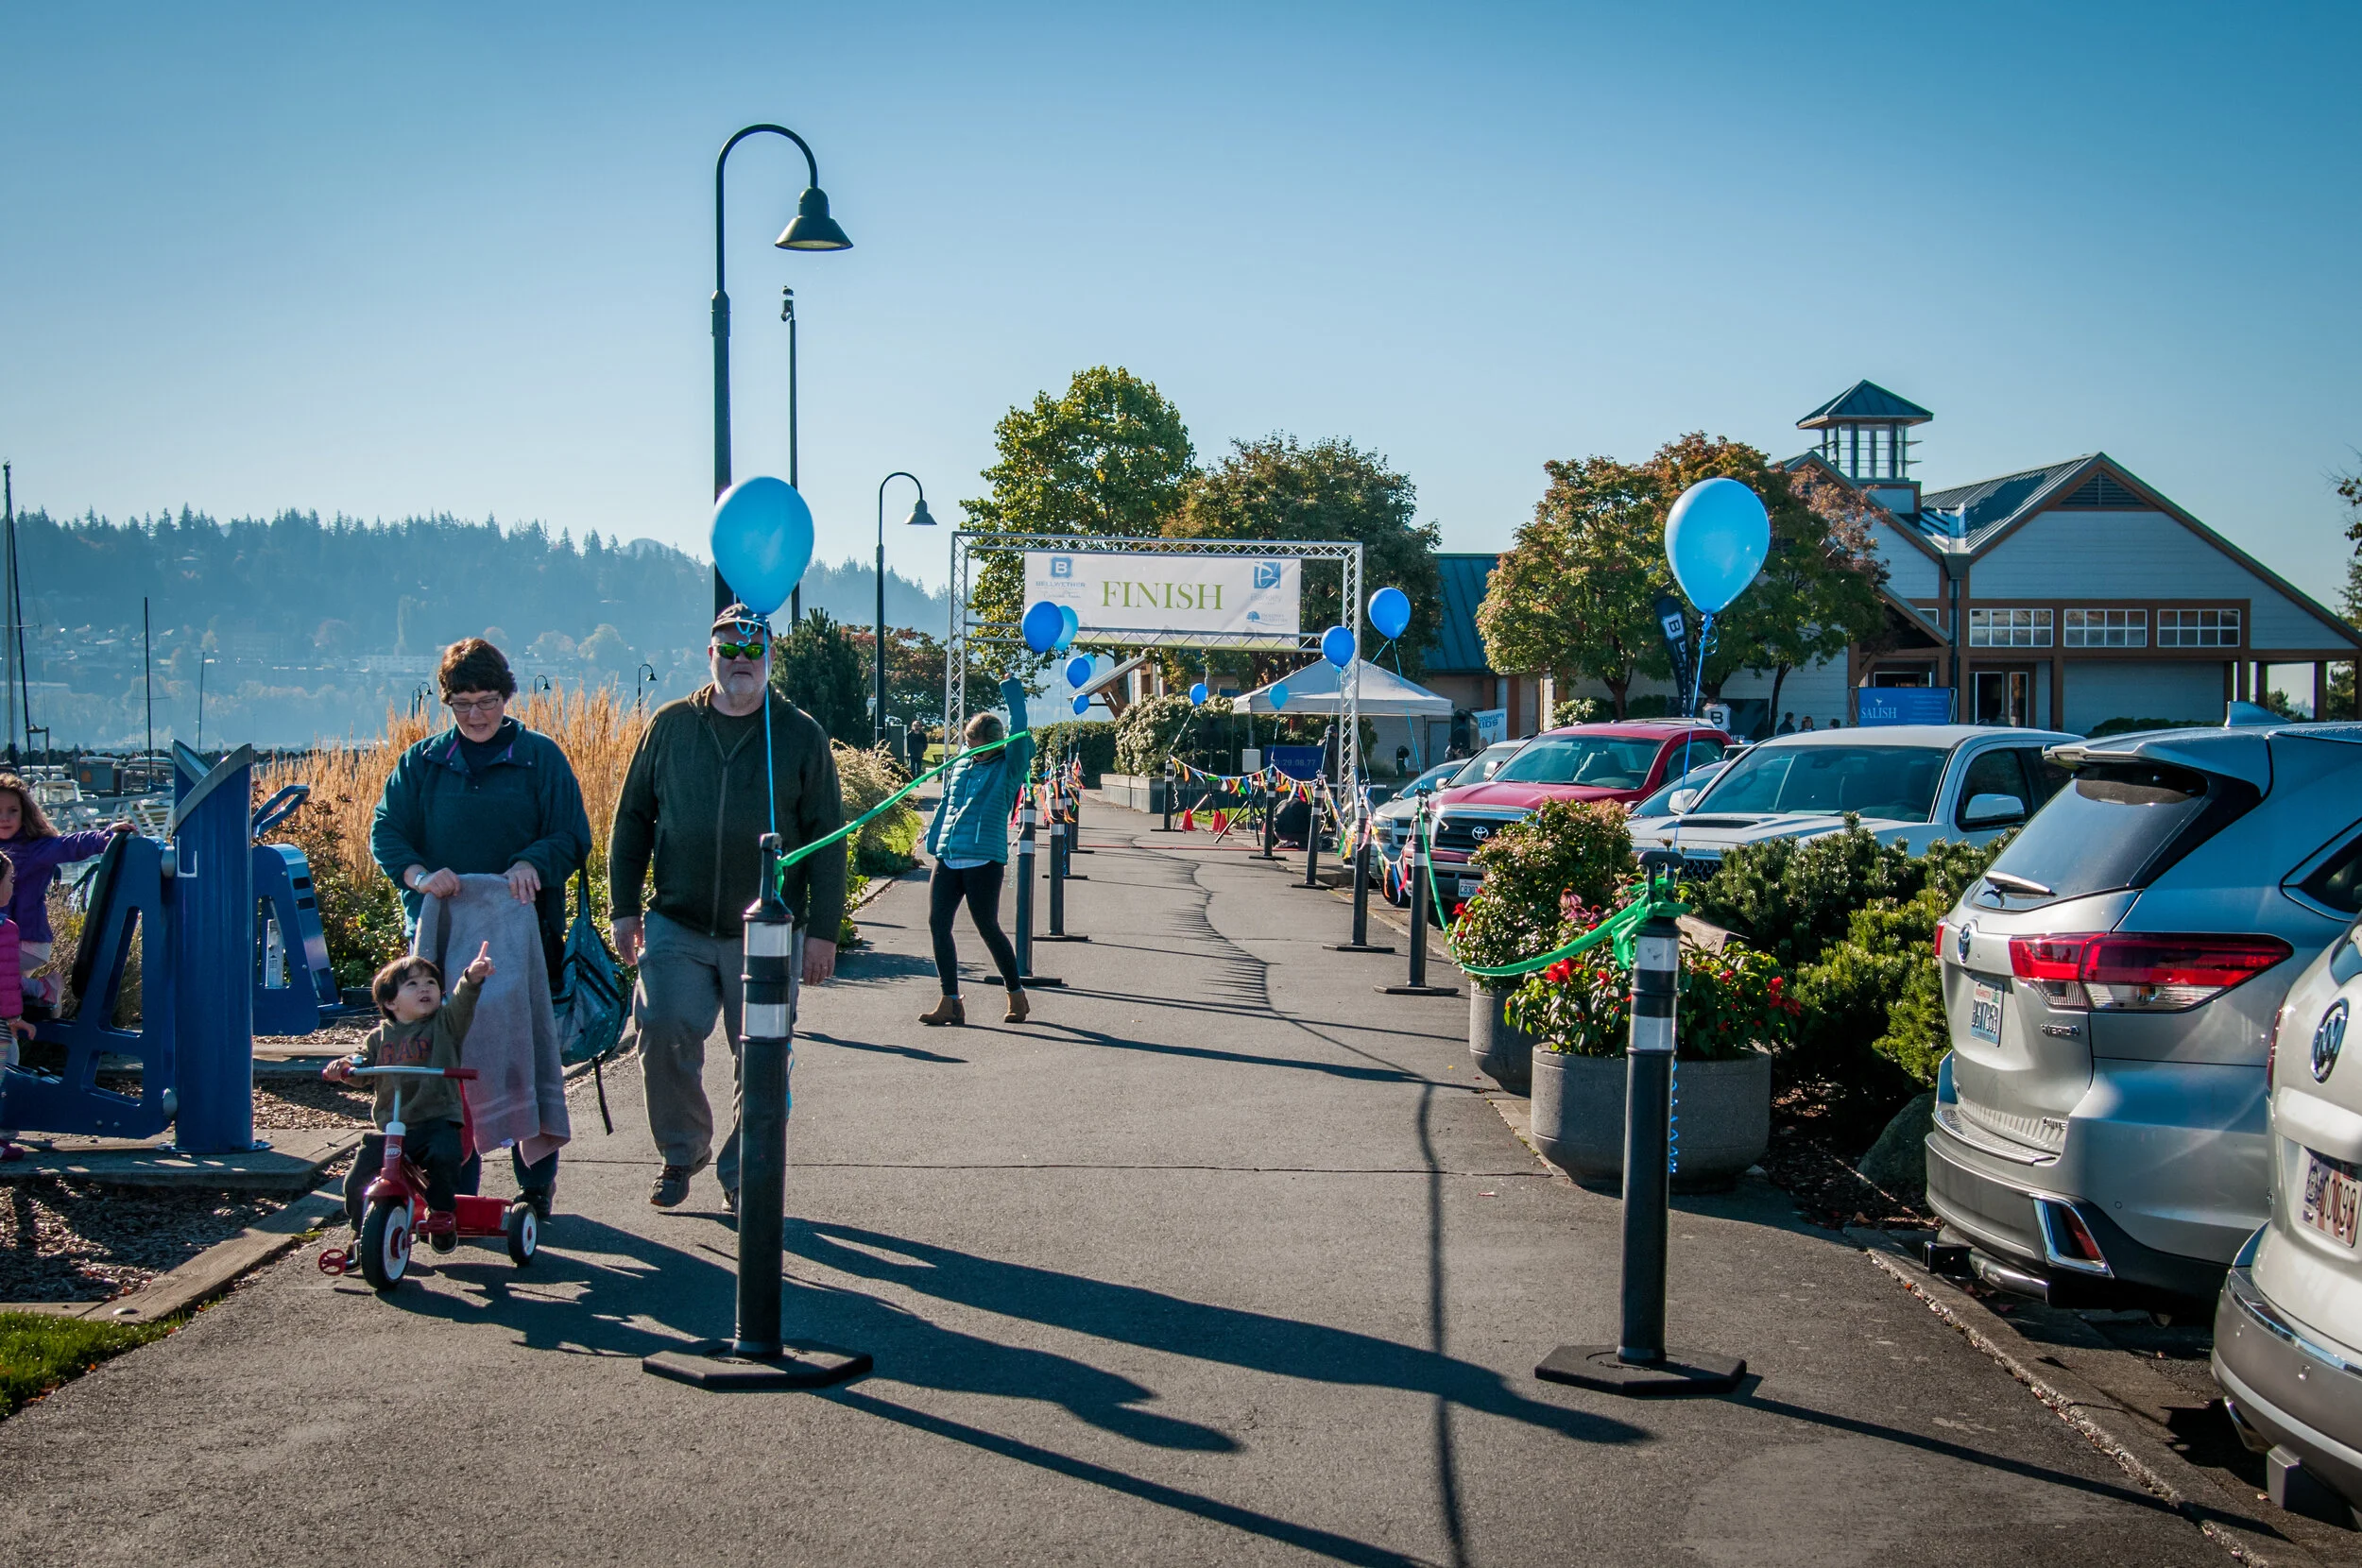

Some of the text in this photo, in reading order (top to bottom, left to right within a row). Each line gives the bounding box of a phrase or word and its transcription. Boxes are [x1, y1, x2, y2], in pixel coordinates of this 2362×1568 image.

[1055, 561, 1068, 573] B
[1101, 581, 1224, 610] FINISH
[1711, 711, 1723, 724] B
[1860, 707, 1898, 719] SALISH
[2041, 1024, 2071, 1036] HYBRID
[380, 1036, 431, 1065] GAP
